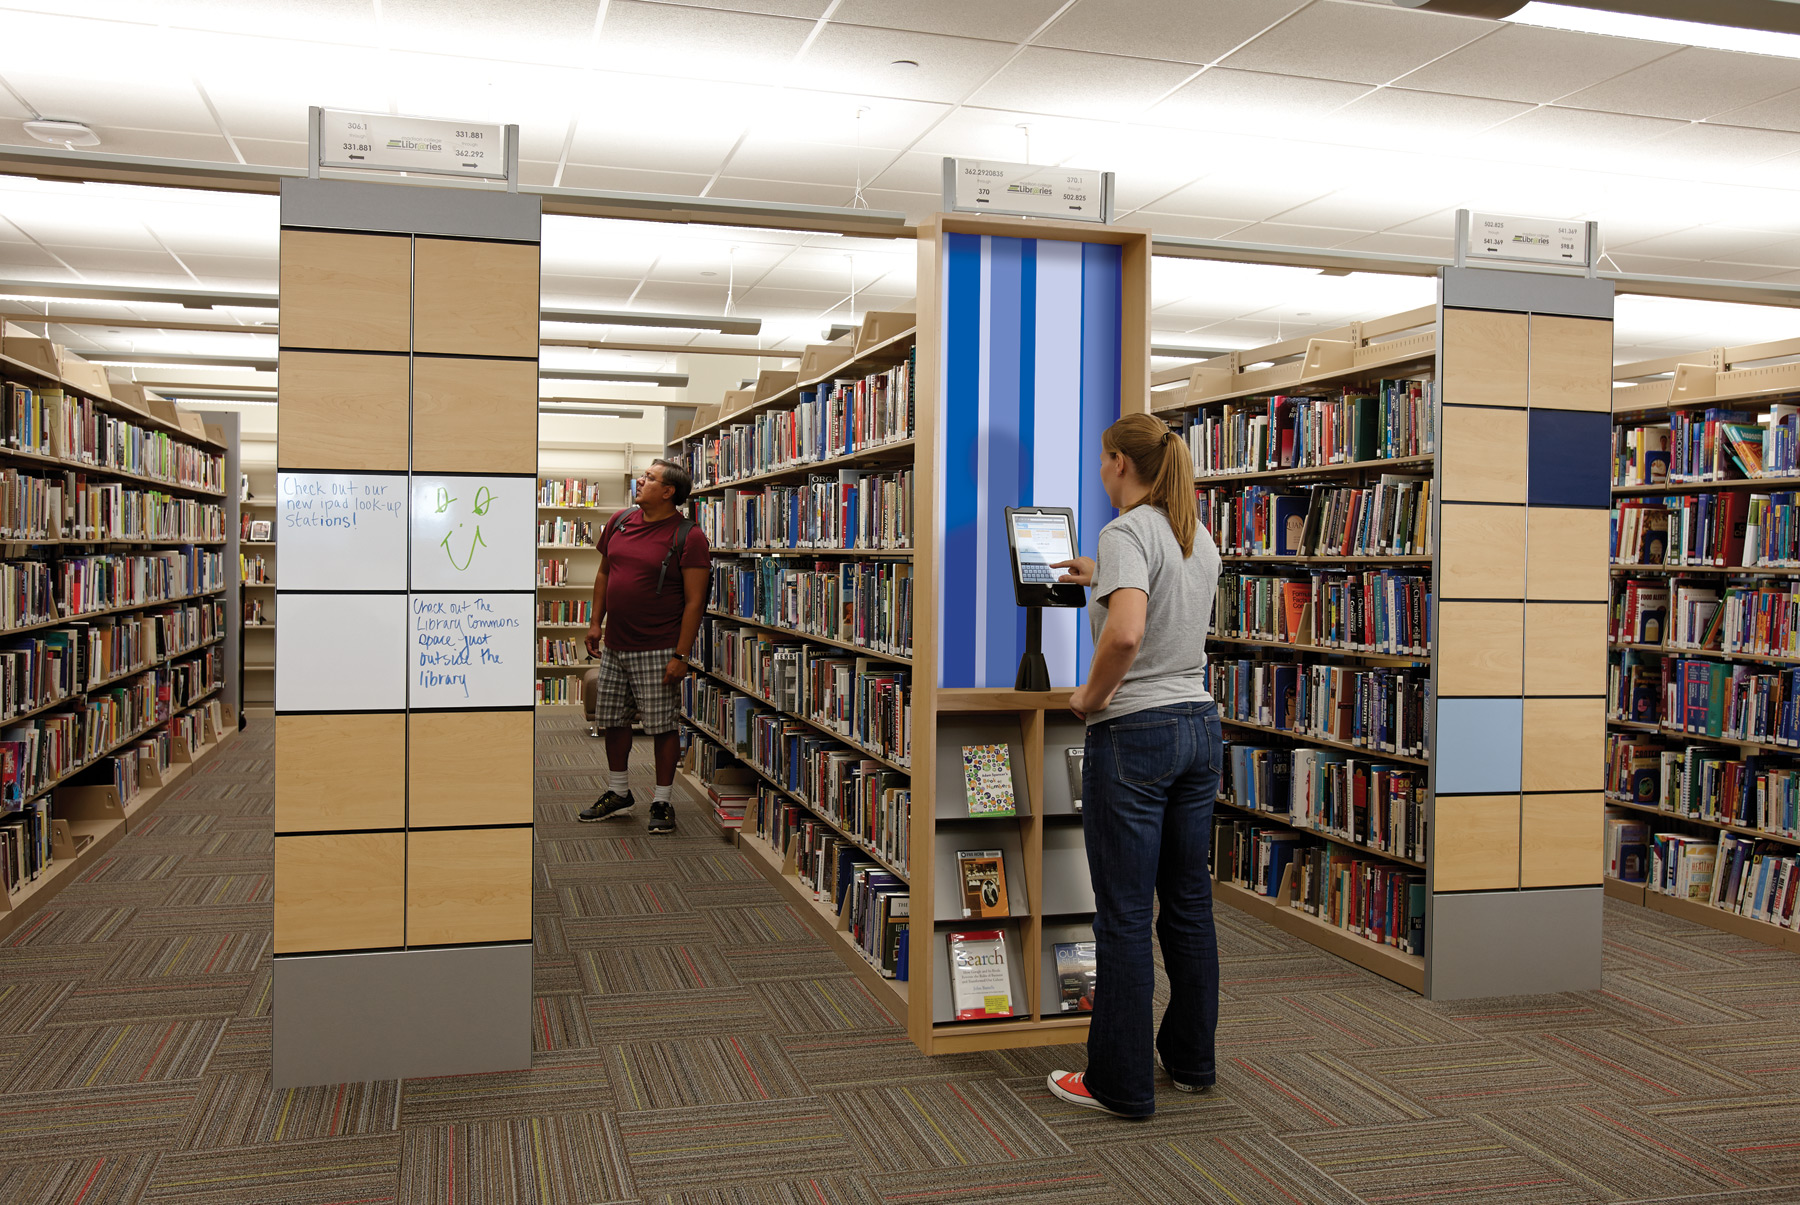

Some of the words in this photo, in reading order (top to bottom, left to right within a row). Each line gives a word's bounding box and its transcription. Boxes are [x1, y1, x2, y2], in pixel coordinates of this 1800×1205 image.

[347, 122, 368, 131] 306.1
[455, 130, 484, 139] 331.881
[342, 143, 372, 152] 331.881
[455, 150, 484, 158] 362.292
[964, 168, 1004, 178] 362.2920835
[1063, 194, 1086, 202] 502.825
[283, 477, 324, 496] Check
[332, 480, 358, 496] out
[364, 485, 389, 496] our
[286, 498, 313, 511] new
[321, 498, 349, 518] ipad
[450, 601, 471, 614] out
[417, 616, 465, 637] Library
[467, 614, 520, 630] Commons
[458, 634, 492, 658] just
[419, 650, 472, 666] outside
[419, 670, 470, 698] library
[957, 949, 1004, 967] Search
